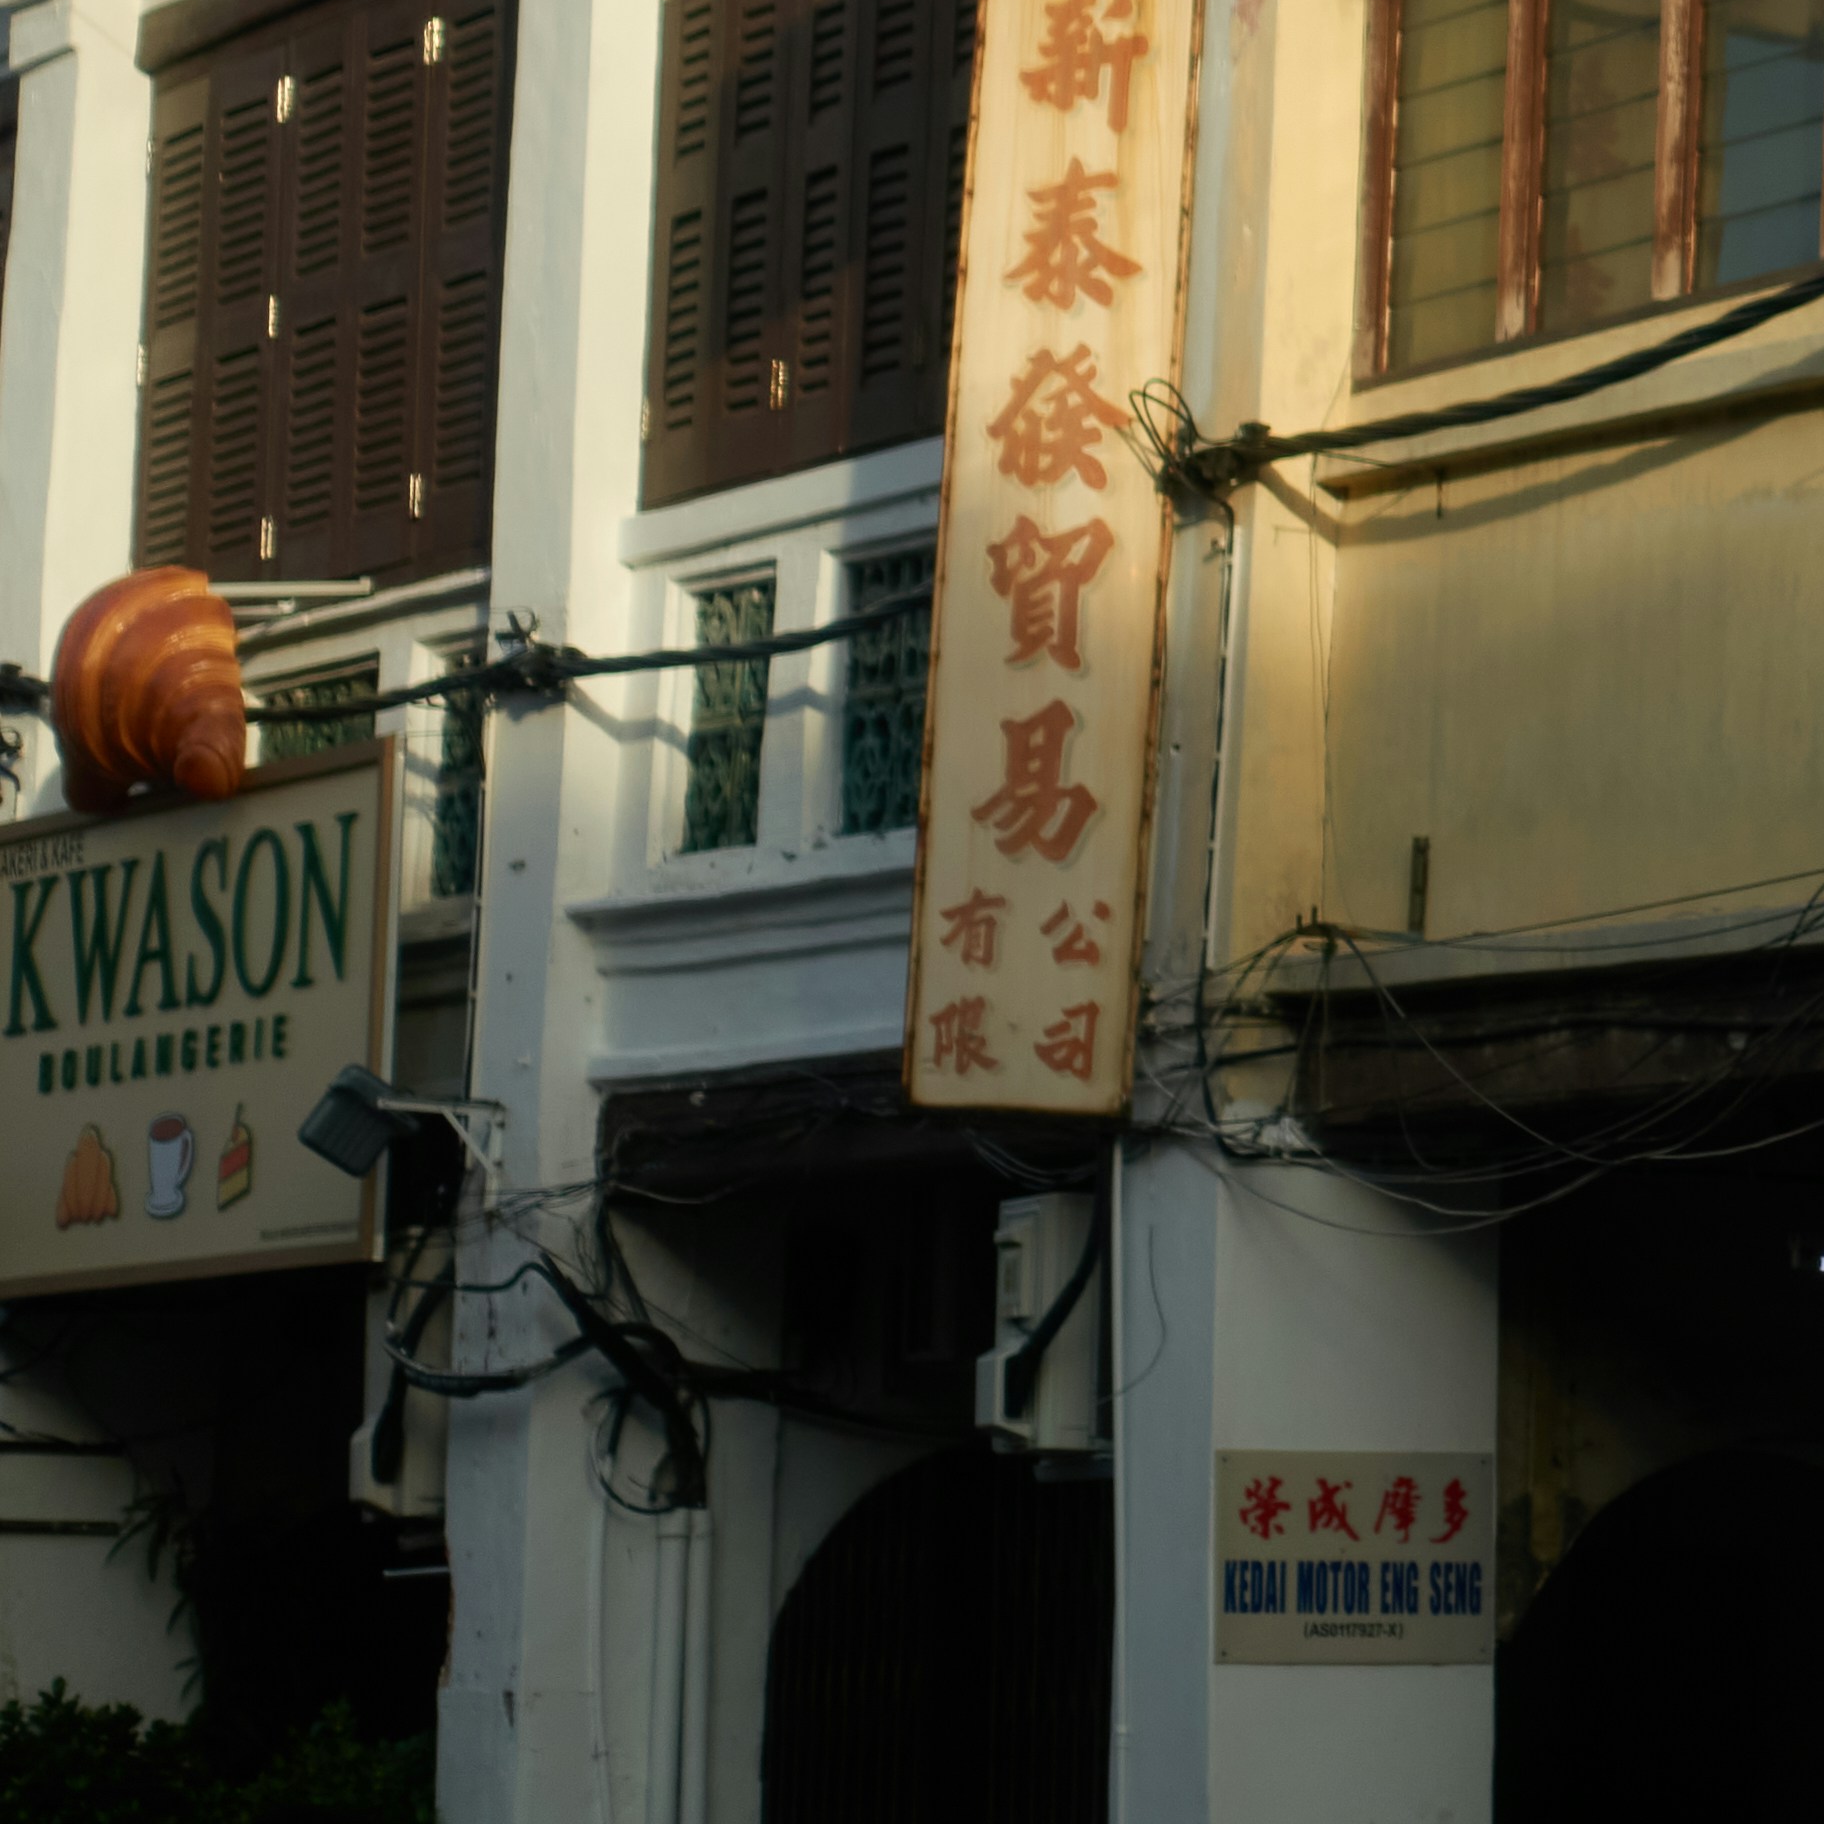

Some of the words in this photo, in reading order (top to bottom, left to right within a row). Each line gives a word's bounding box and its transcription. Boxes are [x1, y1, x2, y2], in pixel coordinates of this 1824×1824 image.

[4, 811, 359, 1037] KWASON
[38, 1015, 290, 1095] BOULANGERIE
[1224, 1560, 1286, 1614] KEDAI
[1297, 1560, 1370, 1615] MOTOR
[1380, 1560, 1418, 1615] ENG
[1430, 1560, 1482, 1616] SENG
